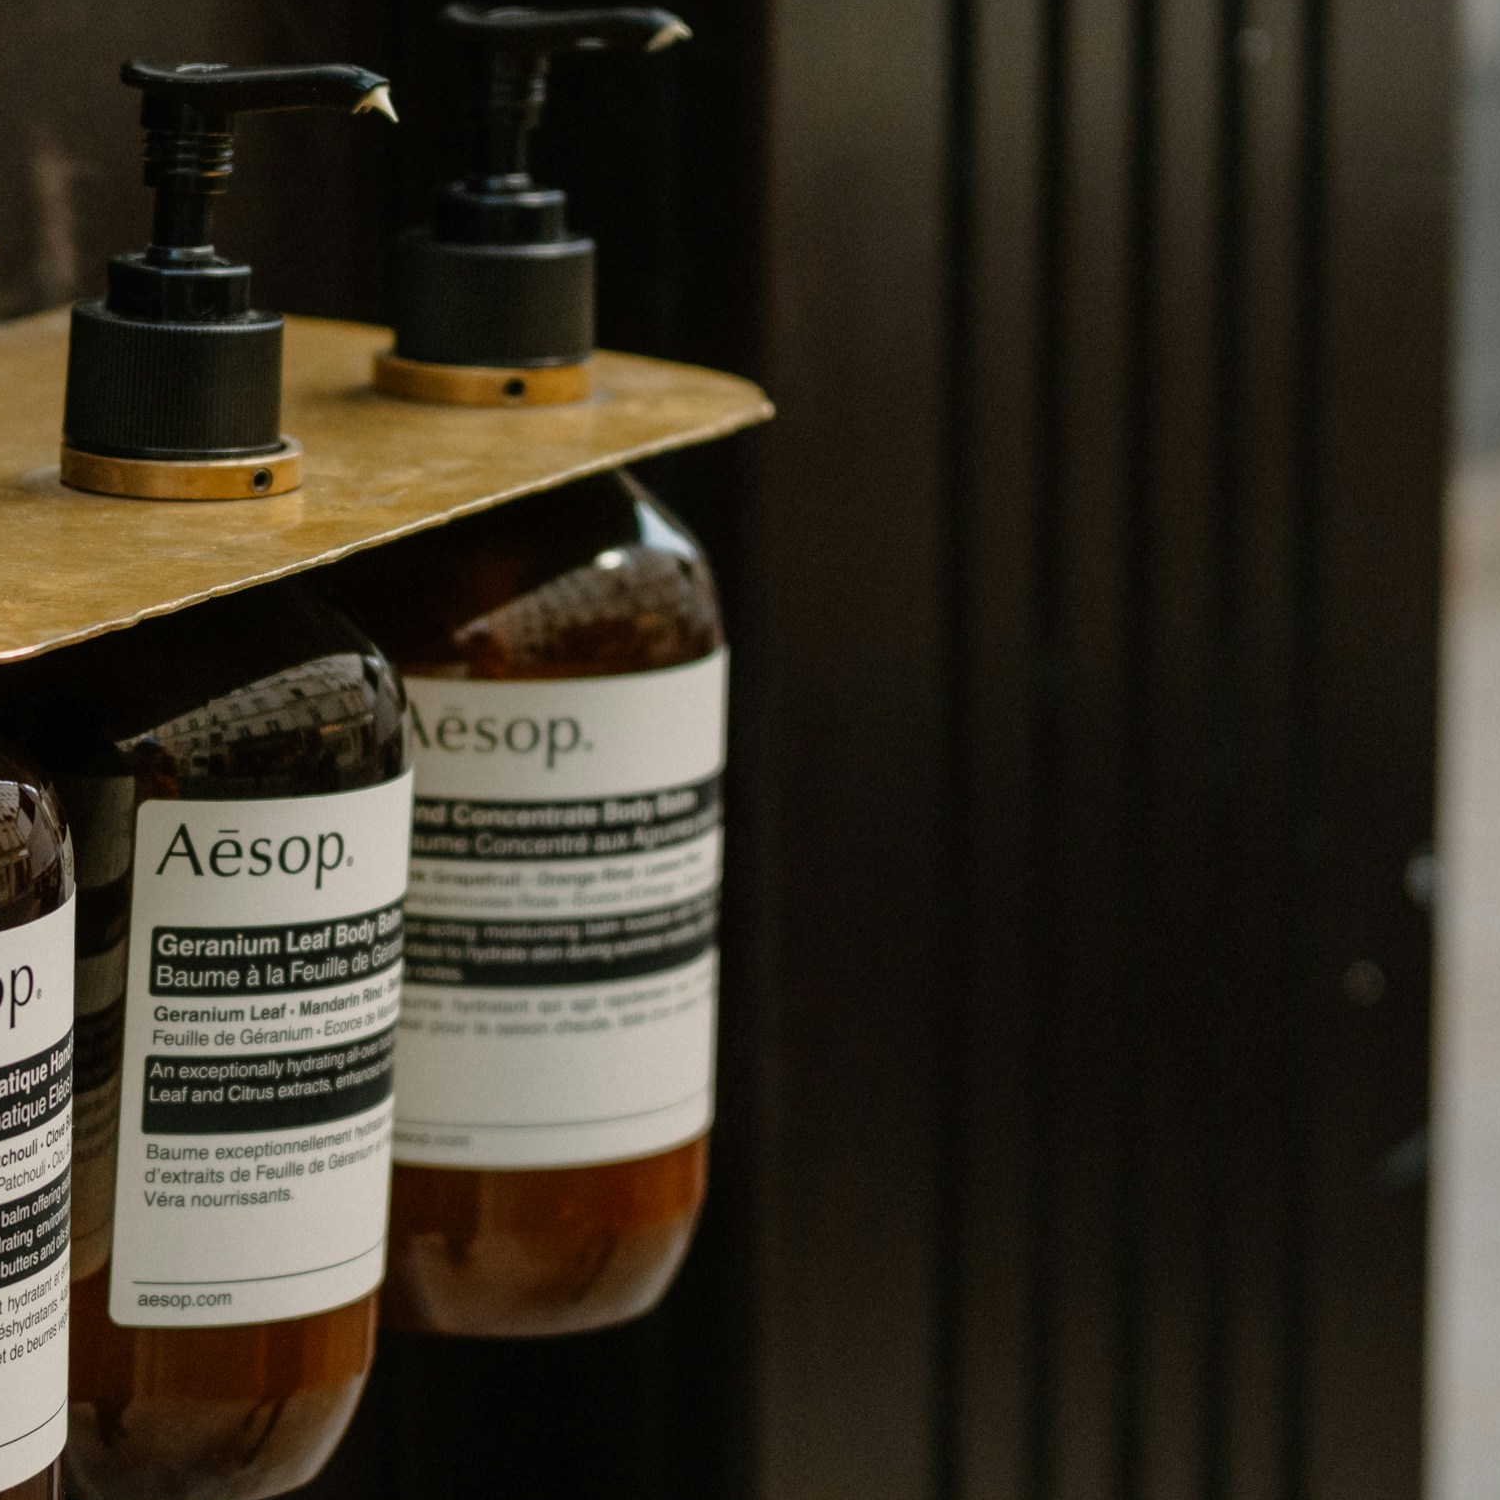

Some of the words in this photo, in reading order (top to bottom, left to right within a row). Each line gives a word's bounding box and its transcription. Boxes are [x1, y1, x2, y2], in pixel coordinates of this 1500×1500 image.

[452, 804, 598, 827] Concentrate
[603, 799, 654, 824] Body
[157, 933, 281, 957] Geranium
[286, 926, 332, 952] Leaf
[335, 918, 376, 947] Body
[156, 964, 241, 988] Baume
[246, 964, 261, 986] à
[266, 965, 285, 985] la
[290, 955, 348, 983] Feuille
[351, 950, 369, 973] de
[153, 1004, 245, 1023] Geranium
[250, 1002, 288, 1021] Leaf
[299, 993, 360, 1017] Mandarin
[362, 983, 383, 1007] Rind
[152, 1029, 210, 1046] Feuille
[214, 1027, 236, 1045] de
[240, 1024, 313, 1044] Géranium
[324, 1016, 363, 1037] Ecorce
[150, 1062, 175, 1078] An
[179, 1059, 284, 1082] exceptionally
[286, 1051, 345, 1076] hydrating
[149, 1085, 188, 1102] Leaf
[191, 1085, 224, 1102] and
[228, 1084, 275, 1101] Citrus
[46, 1123, 66, 1149] Clove
[146, 1143, 210, 1160] Baume
[215, 1130, 353, 1161] exceptionnellement
[145, 1167, 225, 1184] d'extraits
[230, 1167, 250, 1183] de
[256, 1161, 304, 1181] Feuille
[308, 1156, 325, 1175] de
[1, 1203, 31, 1228] balm
[31, 1187, 62, 1215] offering
[144, 1190, 186, 1208] Véra
[191, 1186, 294, 1208] nourrissants.
[1, 1250, 39, 1278] butters
[40, 1238, 56, 1262] and
[7, 1276, 52, 1314] hydratant
[137, 1291, 232, 1310] aesop.com
[10, 1342, 25, 1362] de
[26, 1323, 57, 1354] beurres
